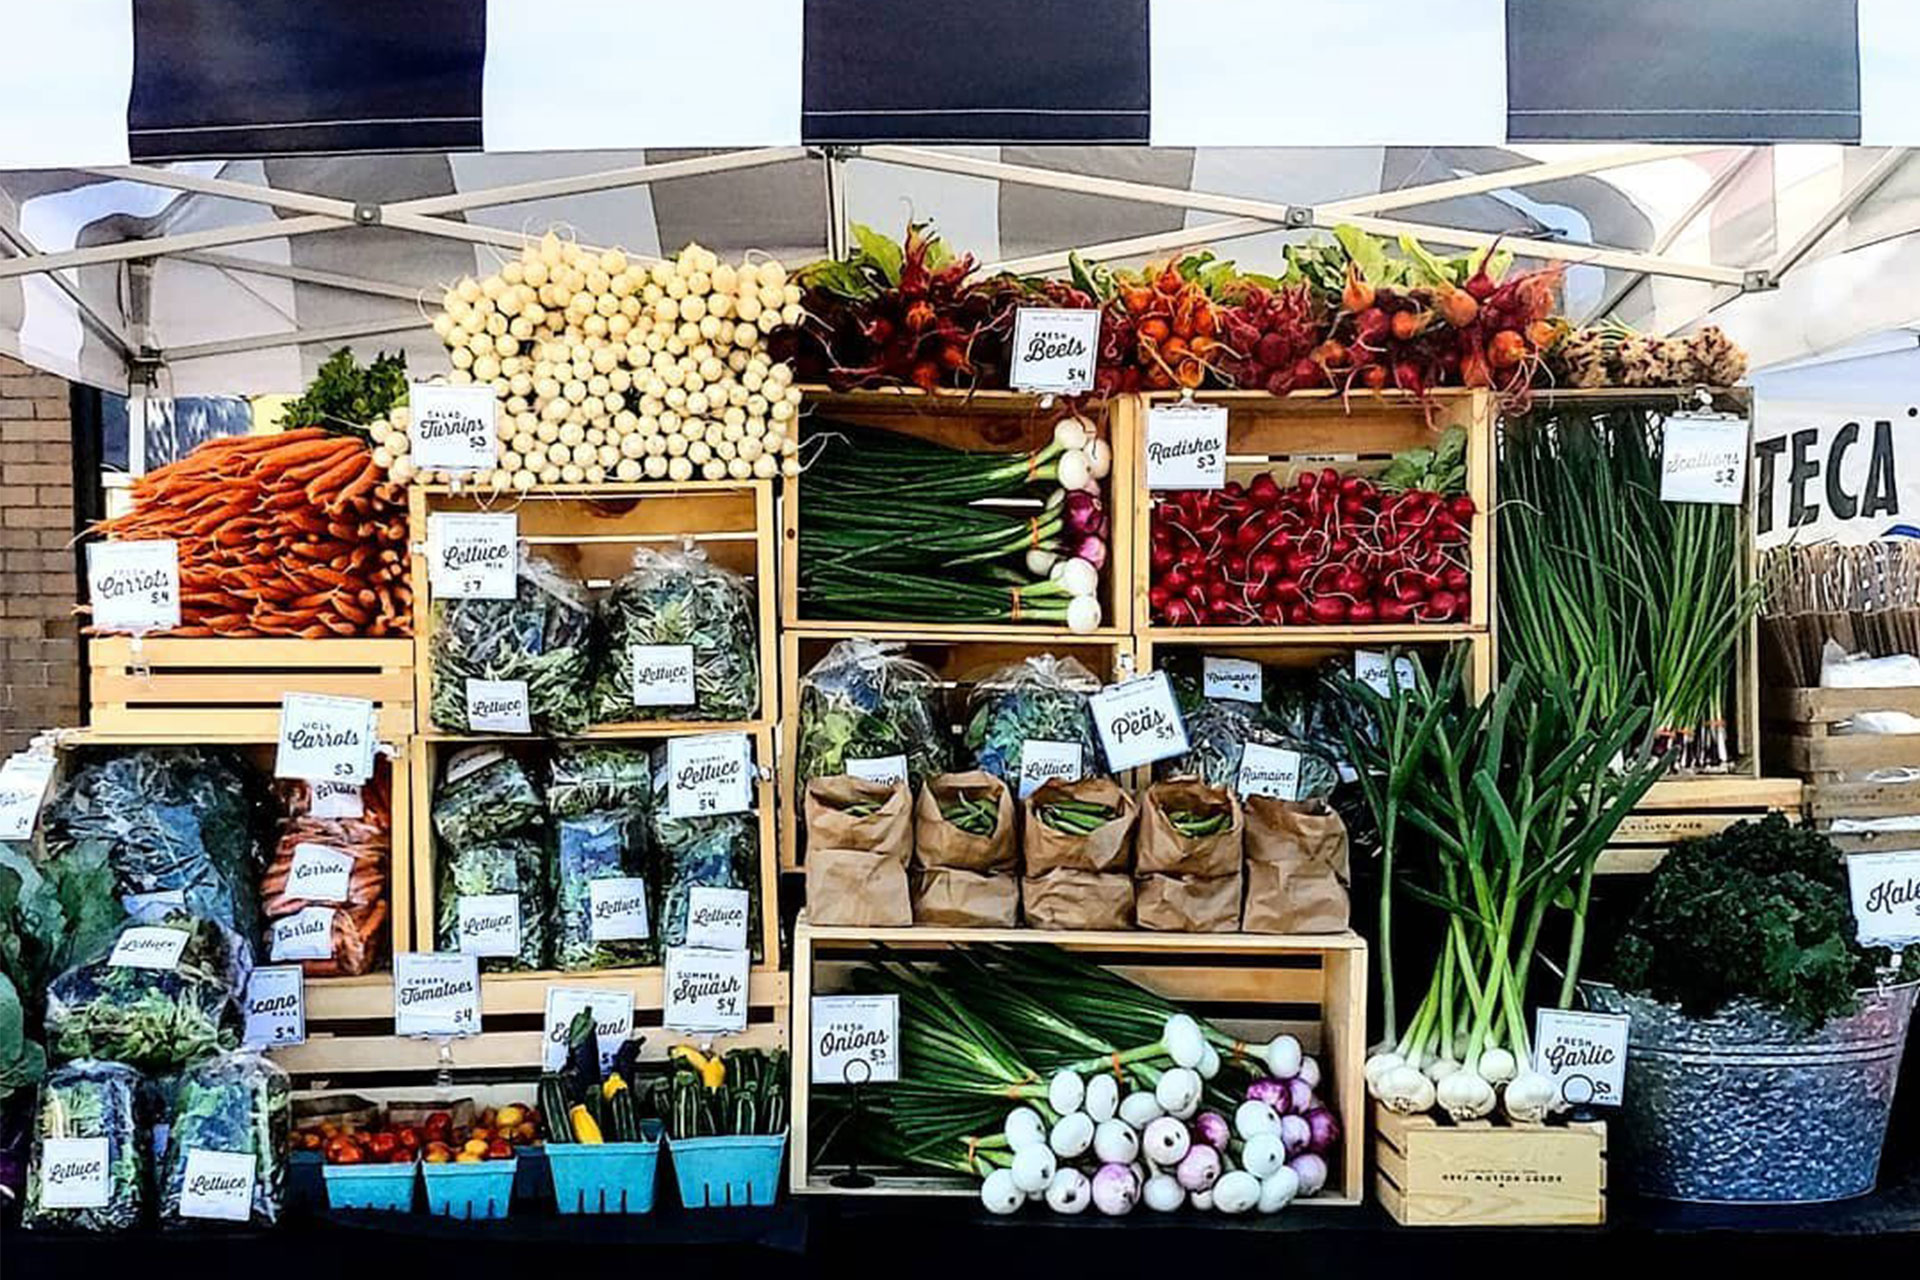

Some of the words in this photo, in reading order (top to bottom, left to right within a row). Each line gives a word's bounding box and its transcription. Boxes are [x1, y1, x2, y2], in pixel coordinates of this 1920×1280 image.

[1023, 336, 1087, 363] Beets
[420, 416, 486, 440] Turnips
[1148, 436, 1222, 466] Radishes
[442, 544, 510, 571] Lettuce
[97, 569, 169, 599] Carrots
[638, 665, 688, 686] Lettuce
[471, 699, 522, 718] Lettuce
[1111, 709, 1166, 743] Peas
[287, 729, 360, 751] Carrots
[676, 760, 741, 790] Lettuce
[1024, 761, 1074, 781] Lettuce
[594, 897, 641, 919] Lettuce
[692, 907, 745, 928] Lettuce
[463, 914, 513, 936] Lettuce
[400, 980, 474, 1006] Tomatoes
[672, 975, 742, 1006] Squash
[550, 1017, 627, 1046] Egant
[819, 1028, 890, 1057] Onions
[1544, 1044, 1616, 1075] Garlic
[48, 1160, 101, 1184] Lettuce
[188, 1174, 247, 1196] Lettuce
